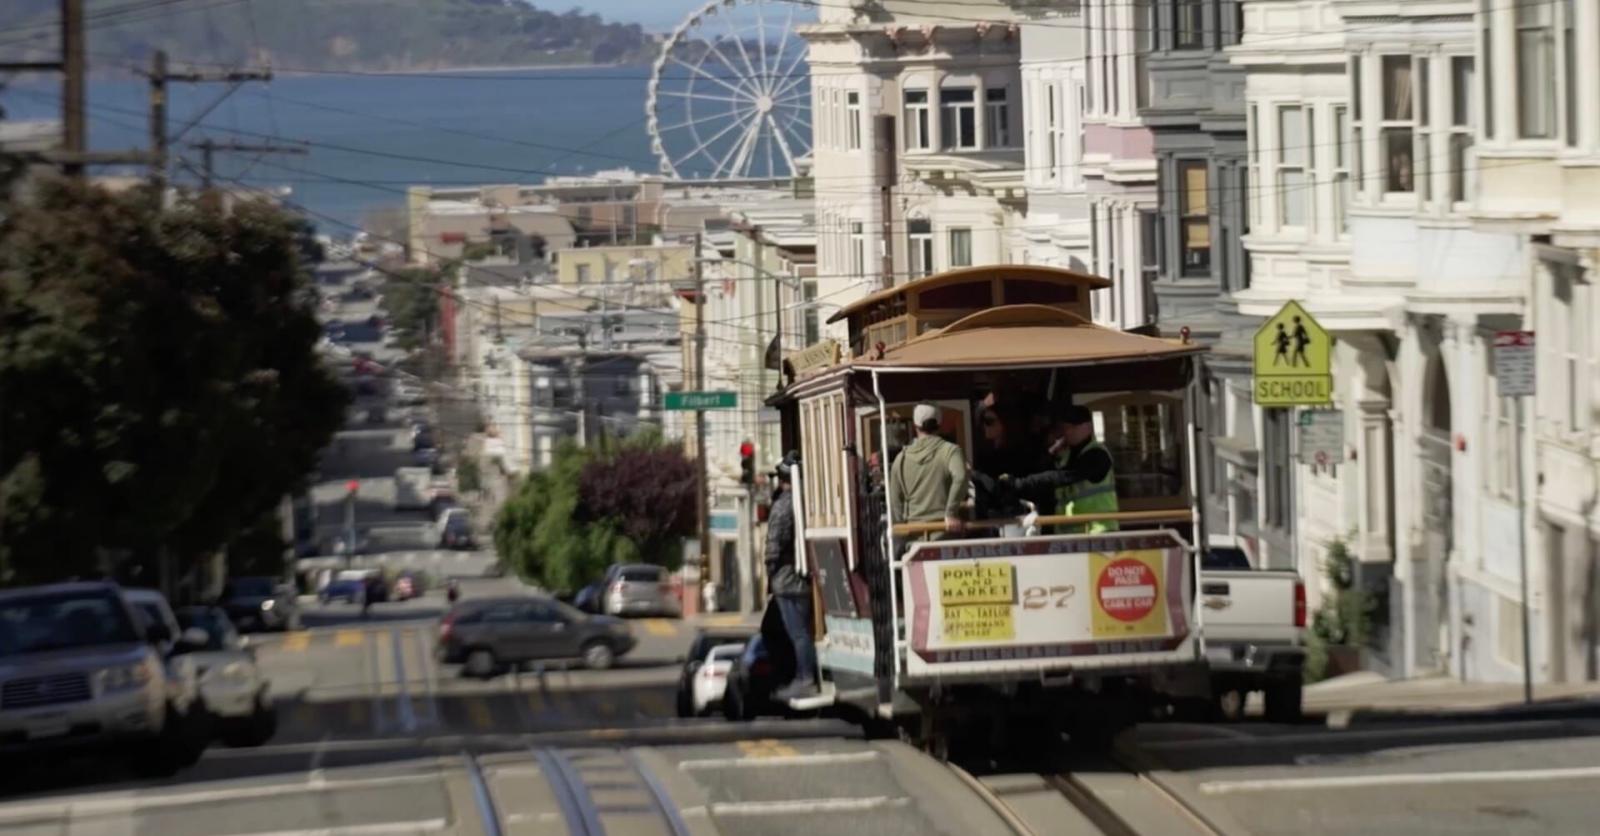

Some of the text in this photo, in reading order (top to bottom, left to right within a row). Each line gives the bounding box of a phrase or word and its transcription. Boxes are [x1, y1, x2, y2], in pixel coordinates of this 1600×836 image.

[1258, 380, 1327, 398] SCHOOL
[680, 394, 720, 407] Filbert
[943, 567, 1007, 580] POWELL
[1107, 565, 1146, 578] DO NOT
[961, 578, 992, 587] AND
[943, 585, 1007, 597] MARKET
[1023, 584, 1076, 610] 27
